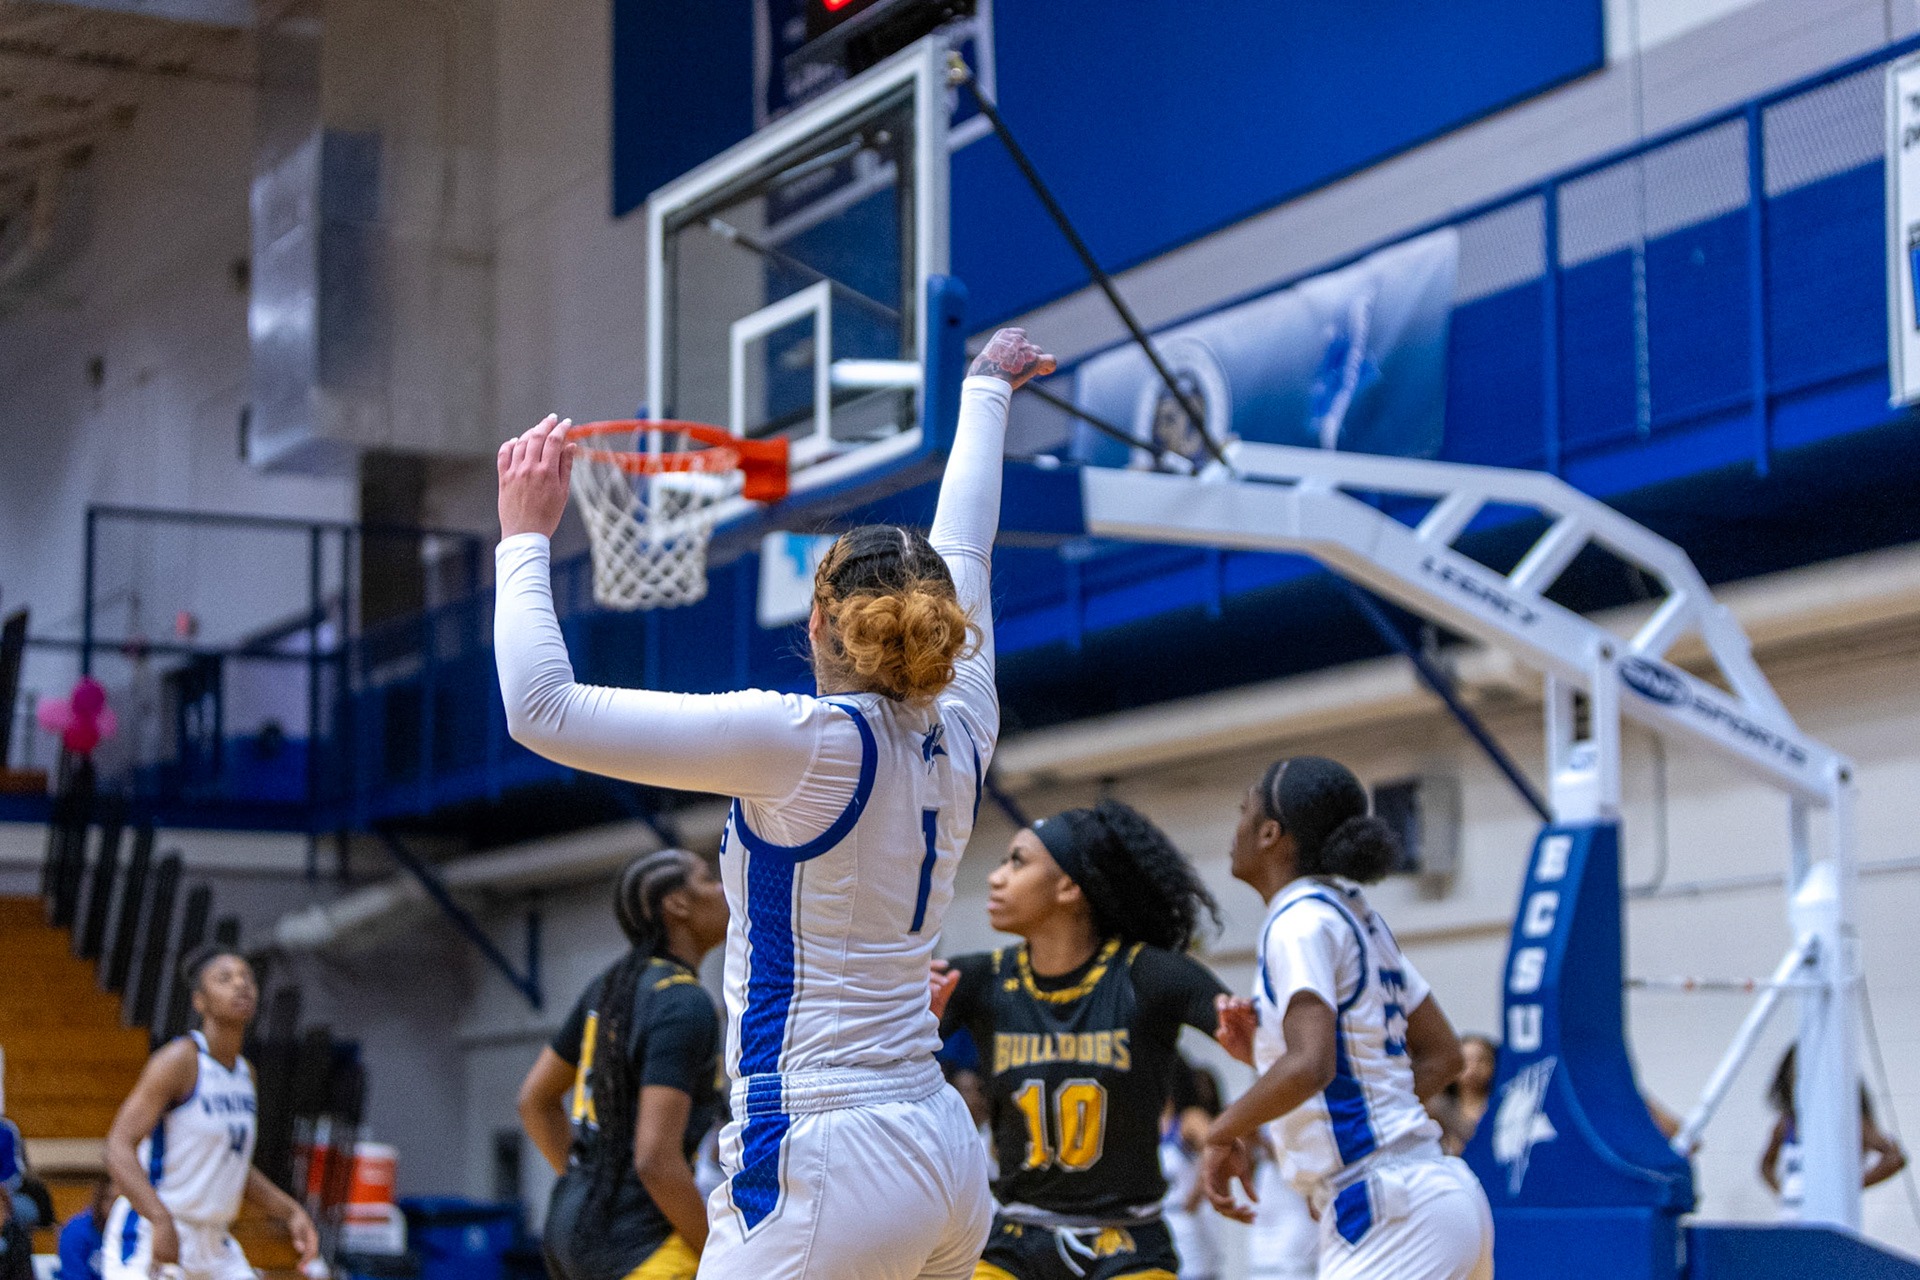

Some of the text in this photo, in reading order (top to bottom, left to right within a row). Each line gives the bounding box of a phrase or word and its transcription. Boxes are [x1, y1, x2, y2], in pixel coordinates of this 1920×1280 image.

[908, 806, 939, 935] 1
[993, 1029, 1132, 1074] BULLDOGS
[1013, 1078, 1108, 1172] 10
